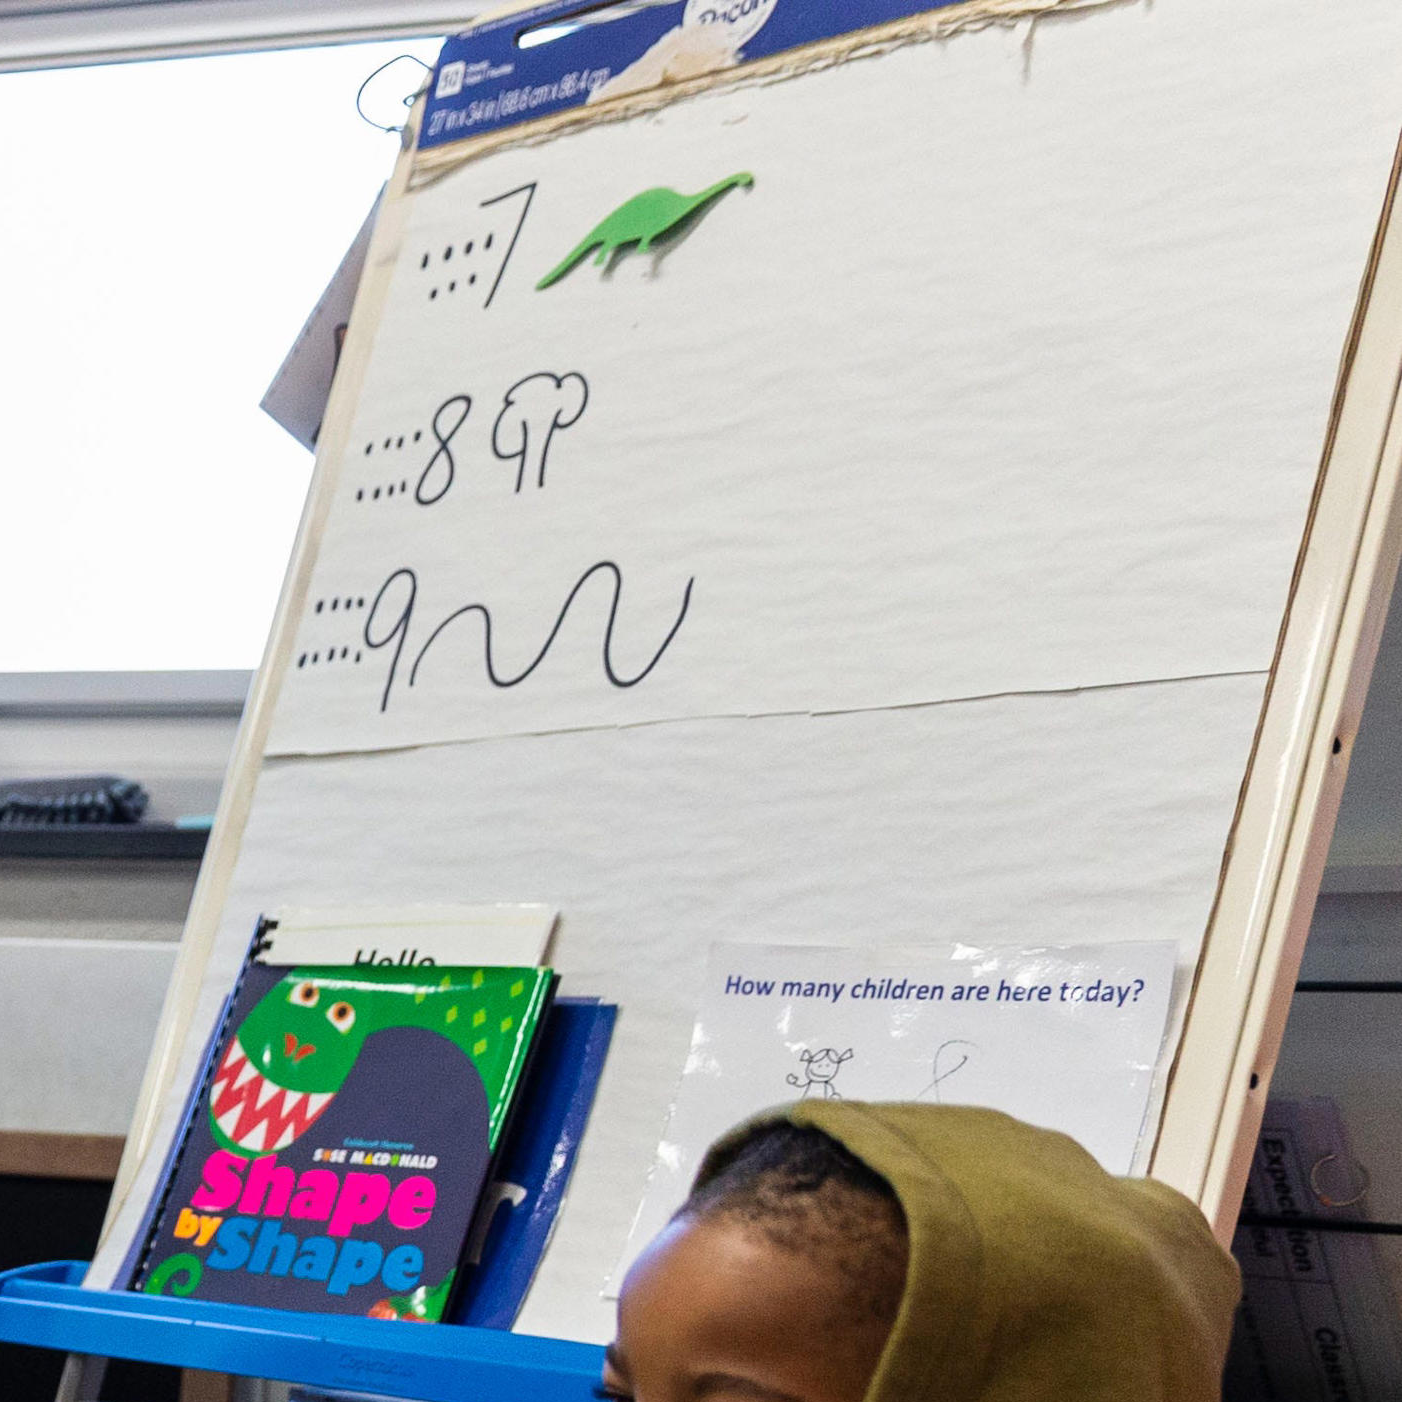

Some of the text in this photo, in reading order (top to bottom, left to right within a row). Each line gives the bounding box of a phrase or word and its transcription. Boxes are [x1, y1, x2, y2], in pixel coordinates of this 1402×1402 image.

[480, 181, 538, 309] 7
[415, 394, 471, 506] 8
[364, 567, 417, 712] 9
[724, 975, 1145, 1007] How many children are here today?
[190, 1149, 437, 1237] Shape
[1262, 1137, 1313, 1272] Expecttion
[174, 1207, 424, 1296] by Shape
